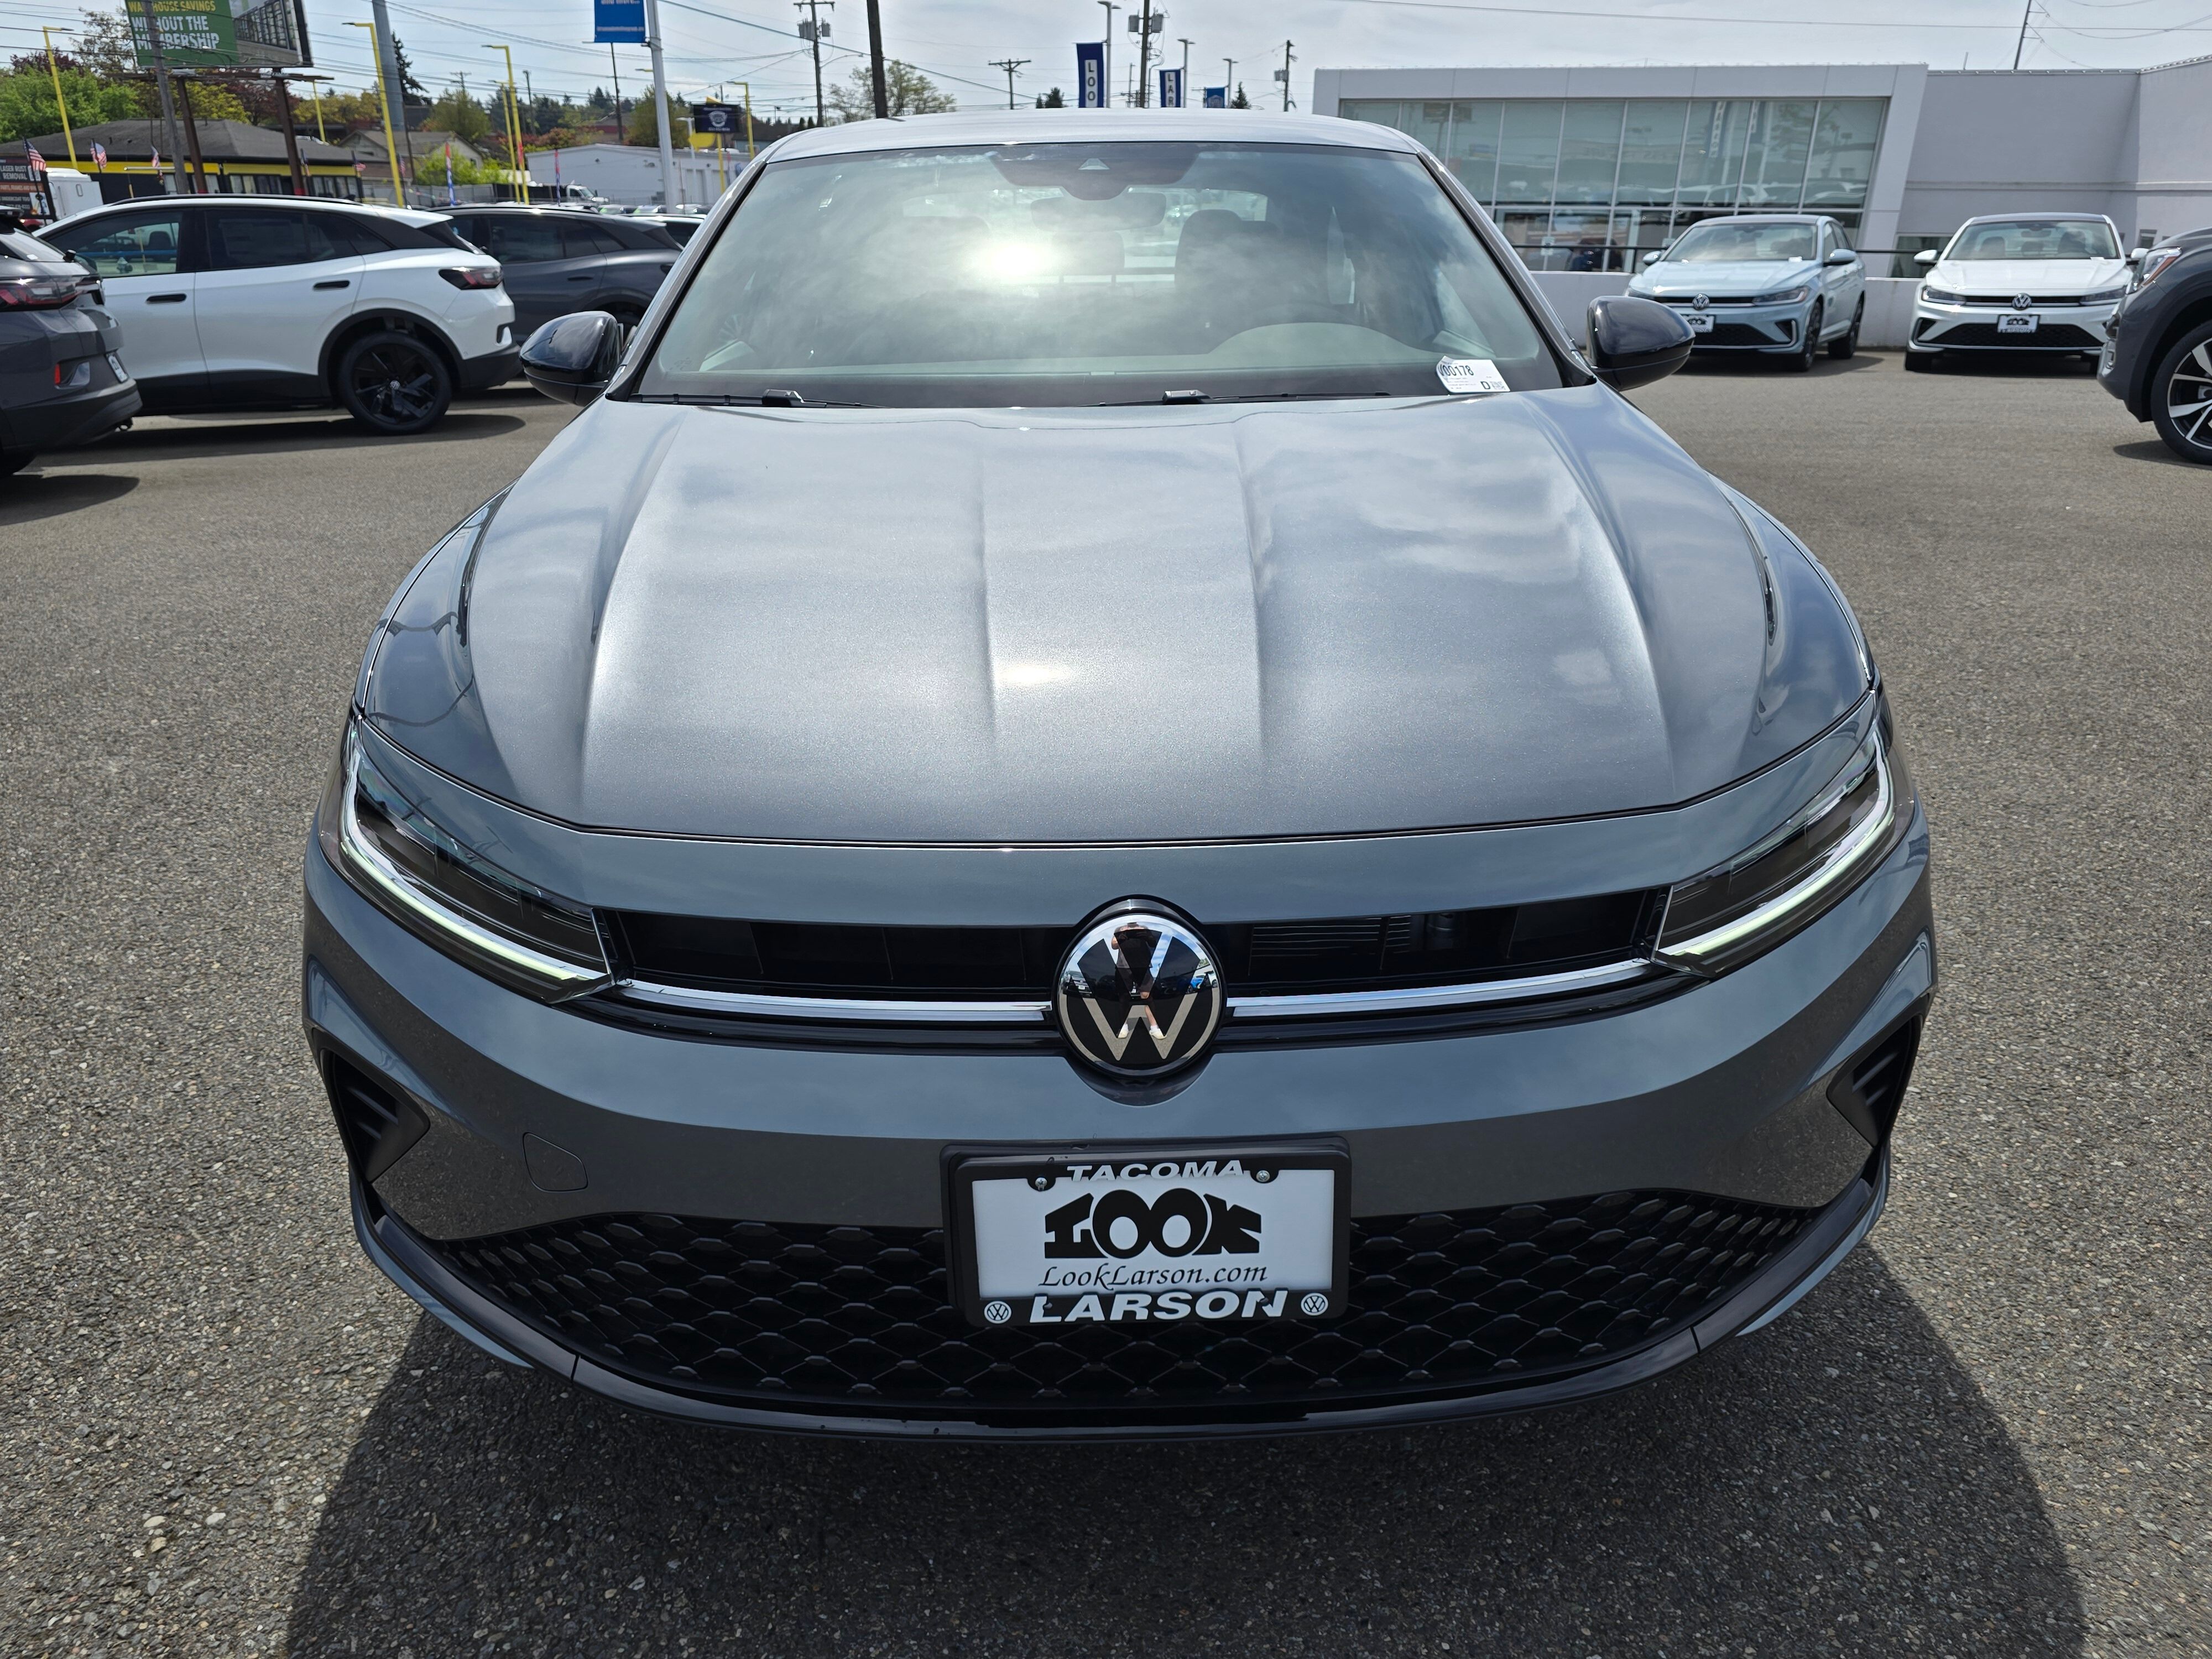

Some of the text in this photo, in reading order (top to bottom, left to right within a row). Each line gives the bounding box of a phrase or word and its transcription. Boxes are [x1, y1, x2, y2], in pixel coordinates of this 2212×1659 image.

[180, 1, 216, 12] SAVINGS
[185, 15, 209, 30] THE
[1066, 1160, 1244, 1182] TACOMA
[1045, 1187, 1262, 1259] LOOK
[1038, 1262, 1269, 1291] LookLarson.com
[1029, 1288, 1288, 1323] LARSON
